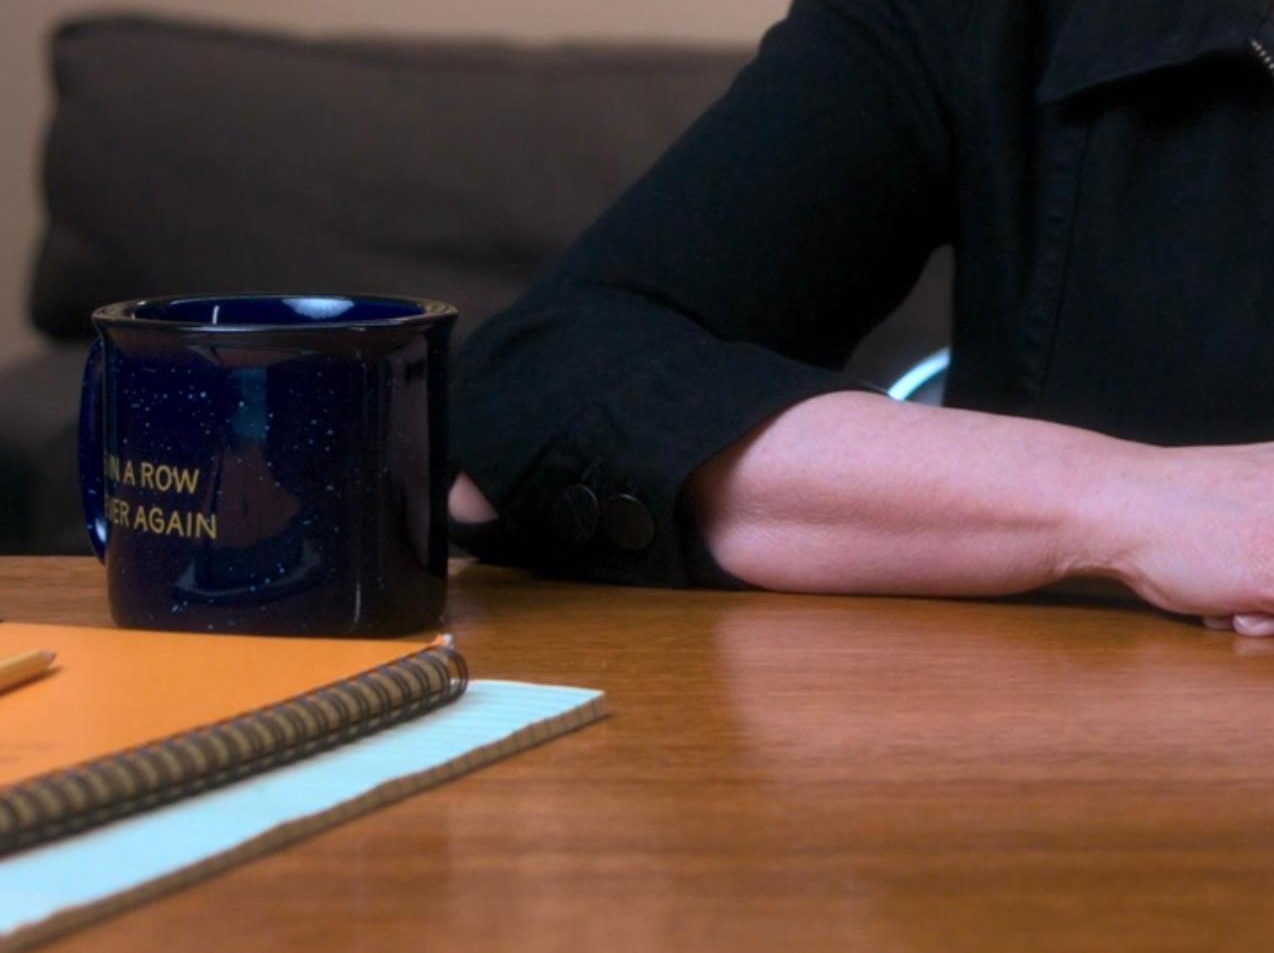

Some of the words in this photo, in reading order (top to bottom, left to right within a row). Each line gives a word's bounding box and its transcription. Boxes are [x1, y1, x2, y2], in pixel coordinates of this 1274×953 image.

[122, 459, 136, 487] A
[140, 461, 200, 494] ROW
[133, 505, 217, 539] AGAIN
